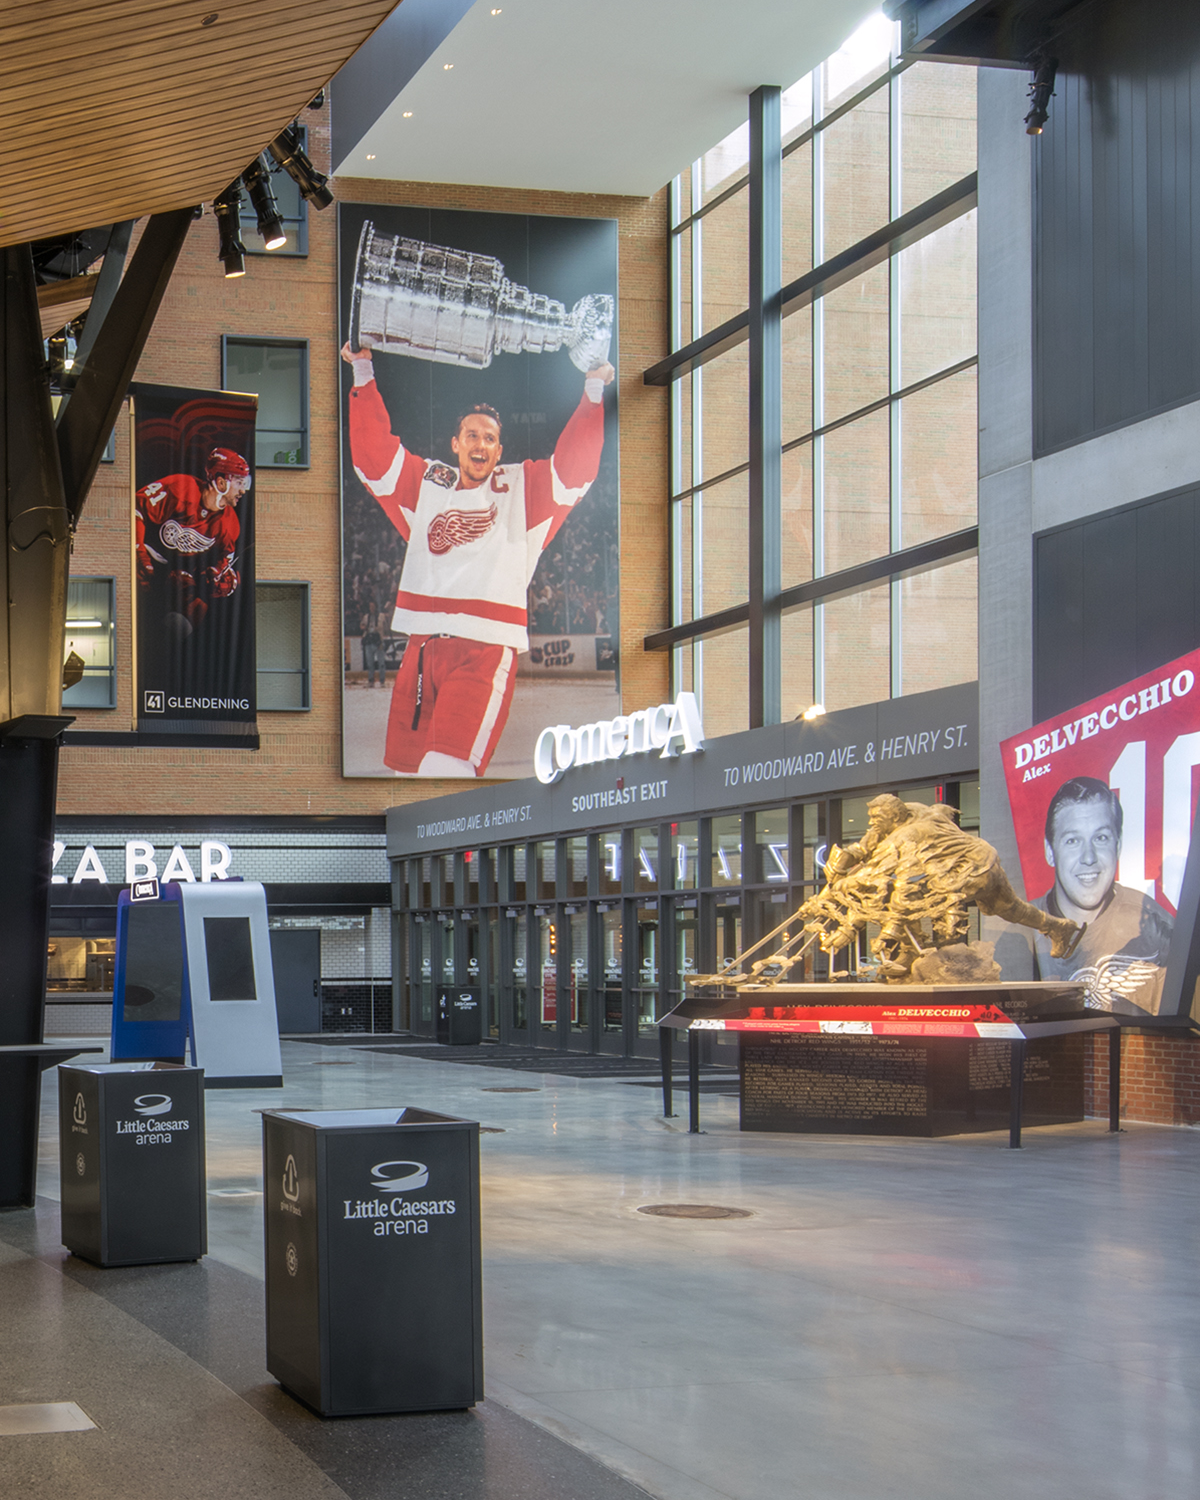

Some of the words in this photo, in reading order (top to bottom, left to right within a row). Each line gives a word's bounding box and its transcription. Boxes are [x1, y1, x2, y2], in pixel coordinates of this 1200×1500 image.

[543, 639, 571, 656] CUP
[147, 695, 161, 708] 41
[167, 697, 250, 710] GLENDENING
[1014, 669, 1195, 769] DELVECCHIO
[724, 766, 740, 787] TO
[742, 751, 825, 784] WOODWARD
[826, 744, 859, 770] AVE.
[864, 741, 876, 764] &
[880, 729, 941, 761] HENRY
[943, 724, 968, 750] ST.
[1022, 762, 1051, 783] Alex
[571, 785, 637, 813] SOUTHEAST
[640, 780, 669, 802] EXIT
[416, 824, 426, 839] TO
[426, 818, 466, 837] WOODWARD
[466, 814, 482, 832] AVE.
[484, 813, 491, 827] &
[491, 808, 520, 827] HENRY
[520, 805, 532, 821] ST.
[125, 840, 232, 884] BAR
[897, 1008, 970, 1018] DELVECCHIO
[116, 1120, 146, 1134] Little
[146, 1118, 189, 1132] Caesars
[135, 1132, 172, 1145] arena
[343, 1199, 389, 1219] Little
[390, 1197, 456, 1217] Caesars
[373, 1219, 428, 1236] arena
